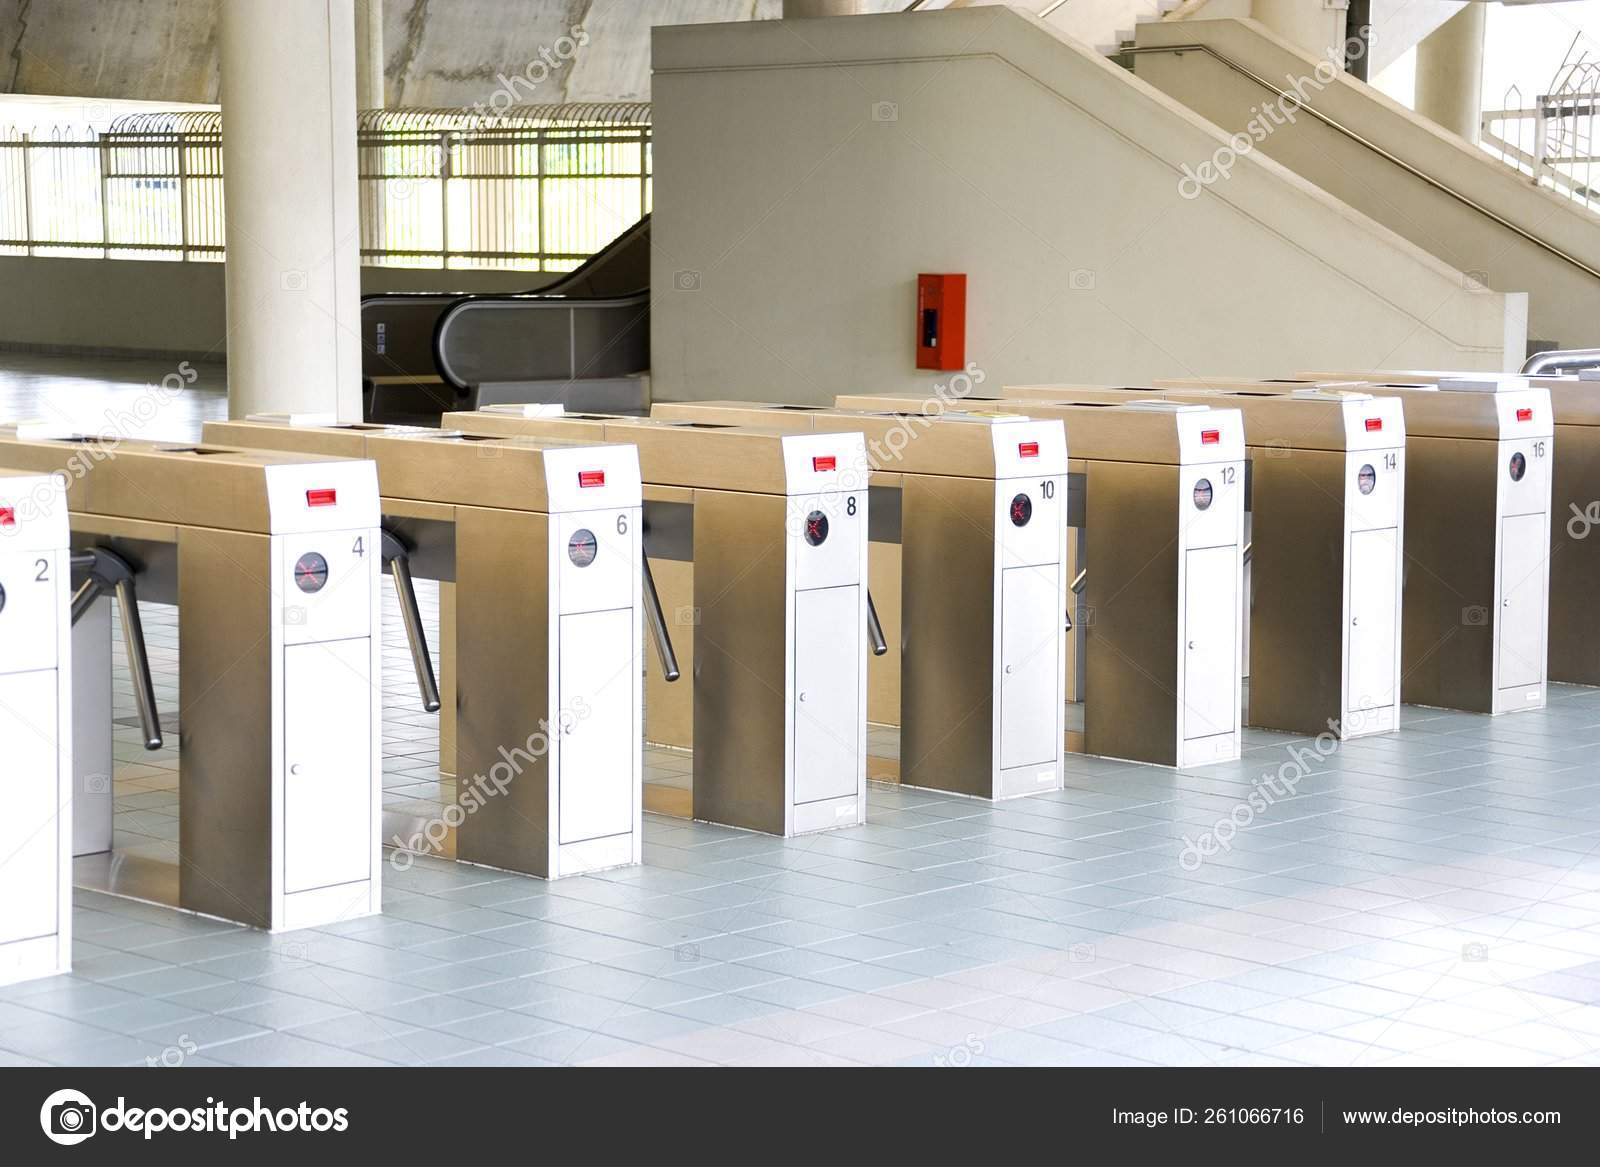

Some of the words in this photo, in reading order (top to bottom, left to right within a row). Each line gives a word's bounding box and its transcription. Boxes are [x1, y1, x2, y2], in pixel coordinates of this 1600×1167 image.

[1533, 441, 1545, 458] 16
[1384, 454, 1398, 471] 14
[1221, 467, 1236, 486] 12
[1038, 480, 1056, 500] 10
[847, 496, 857, 517] 8
[616, 514, 628, 536] 6
[352, 536, 365, 558] 4
[35, 558, 49, 582] 2
